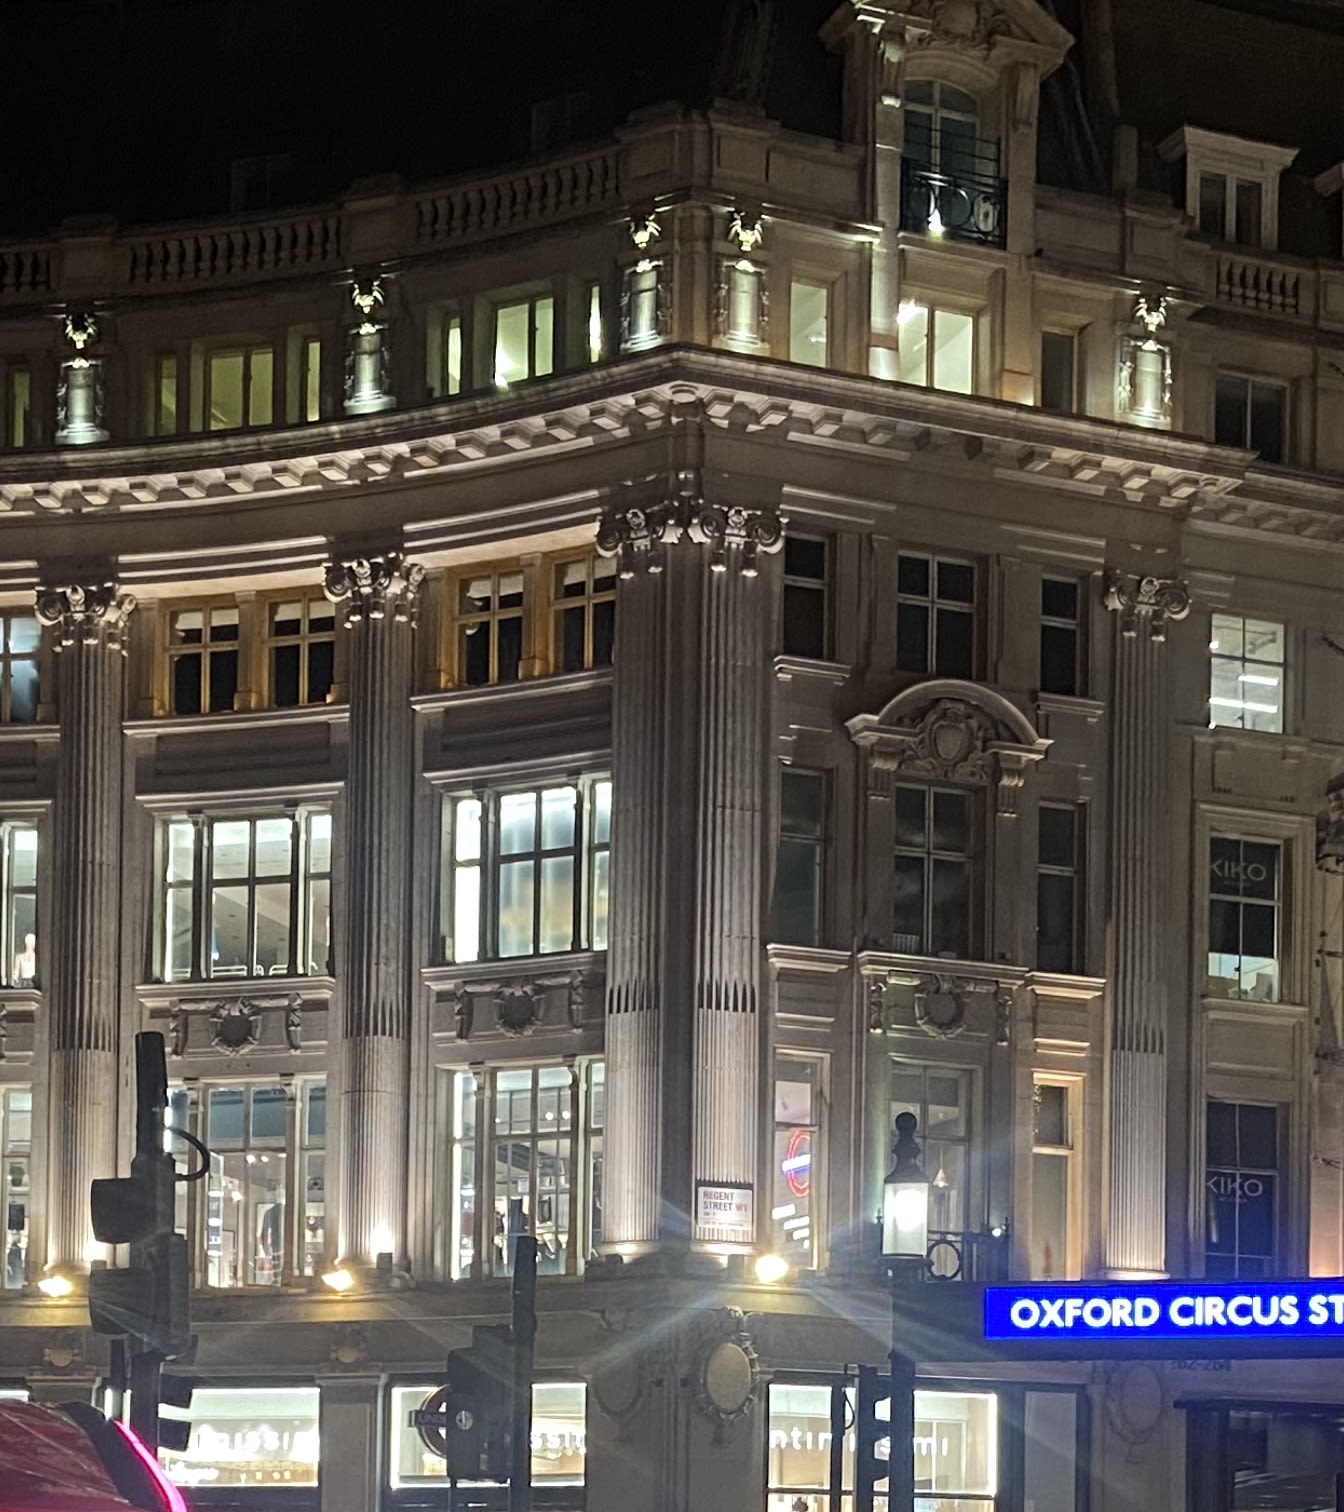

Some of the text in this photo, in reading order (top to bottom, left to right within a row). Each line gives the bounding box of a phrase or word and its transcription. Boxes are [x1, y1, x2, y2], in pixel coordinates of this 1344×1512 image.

[1206, 1176, 1263, 1197] KIKO
[703, 1191, 735, 1201] REGENT
[703, 1201, 733, 1212] STREET
[1010, 1298, 1160, 1329] OXFORD
[1168, 1296, 1300, 1327] CIRCUS
